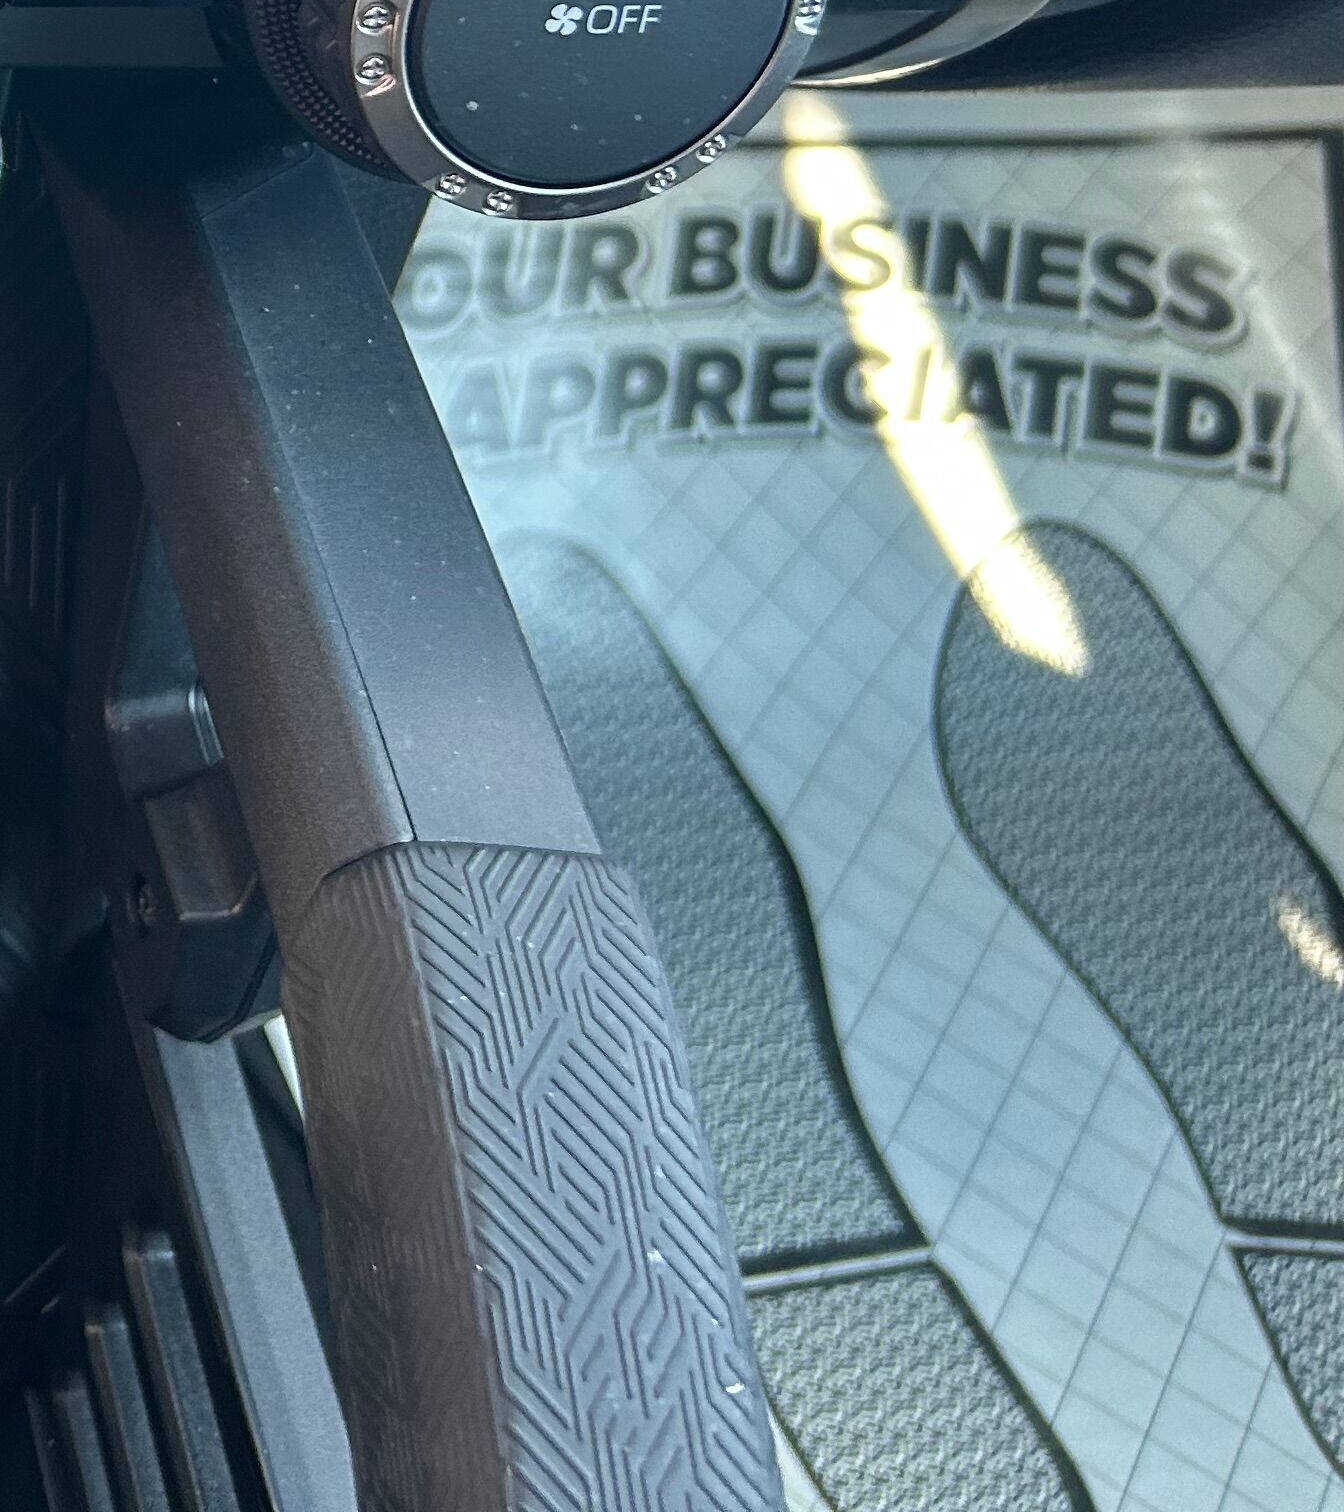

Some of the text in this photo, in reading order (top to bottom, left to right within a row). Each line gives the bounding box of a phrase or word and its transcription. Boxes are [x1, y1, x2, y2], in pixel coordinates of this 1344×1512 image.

[586, 4, 662, 34] OFF
[670, 215, 1238, 334] BUSINESS
[448, 341, 1283, 472] APPRECIATED!
